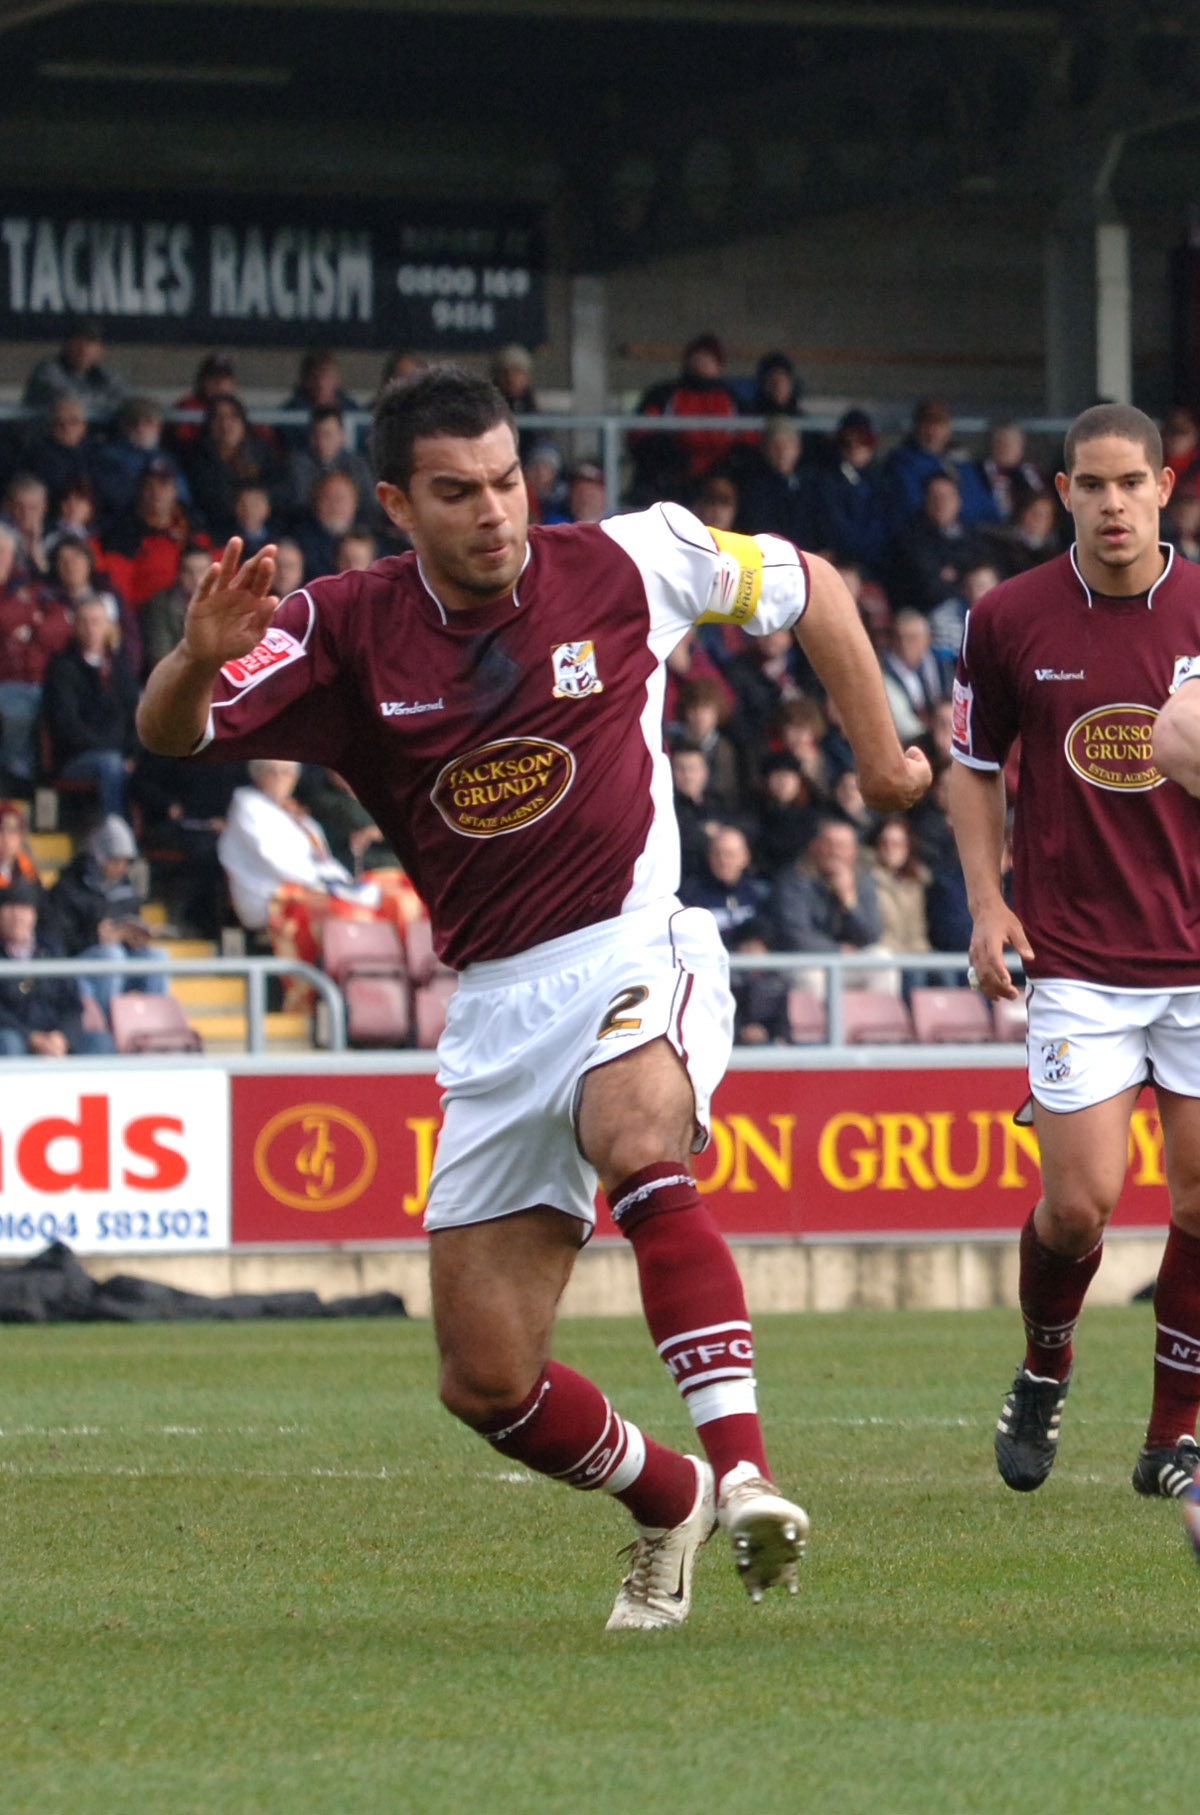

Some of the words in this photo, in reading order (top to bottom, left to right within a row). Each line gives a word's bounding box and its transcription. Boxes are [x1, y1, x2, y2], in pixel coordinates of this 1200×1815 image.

[2, 217, 194, 317] TACKLES
[210, 223, 375, 323] RACISM
[1083, 724, 1153, 744] JACKSO
[1085, 743, 1154, 761] GRUND
[449, 752, 554, 789] JACKSON
[453, 770, 551, 808] GRUNDY
[1087, 762, 1122, 782] ESTATE
[458, 811, 498, 829] ESTATE
[499, 795, 546, 825] AGENTS
[596, 984, 650, 1040] 2
[0, 1093, 190, 1196] ds
[817, 1110, 1168, 1192] GRUNY
[96, 1208, 210, 1241] 582502
